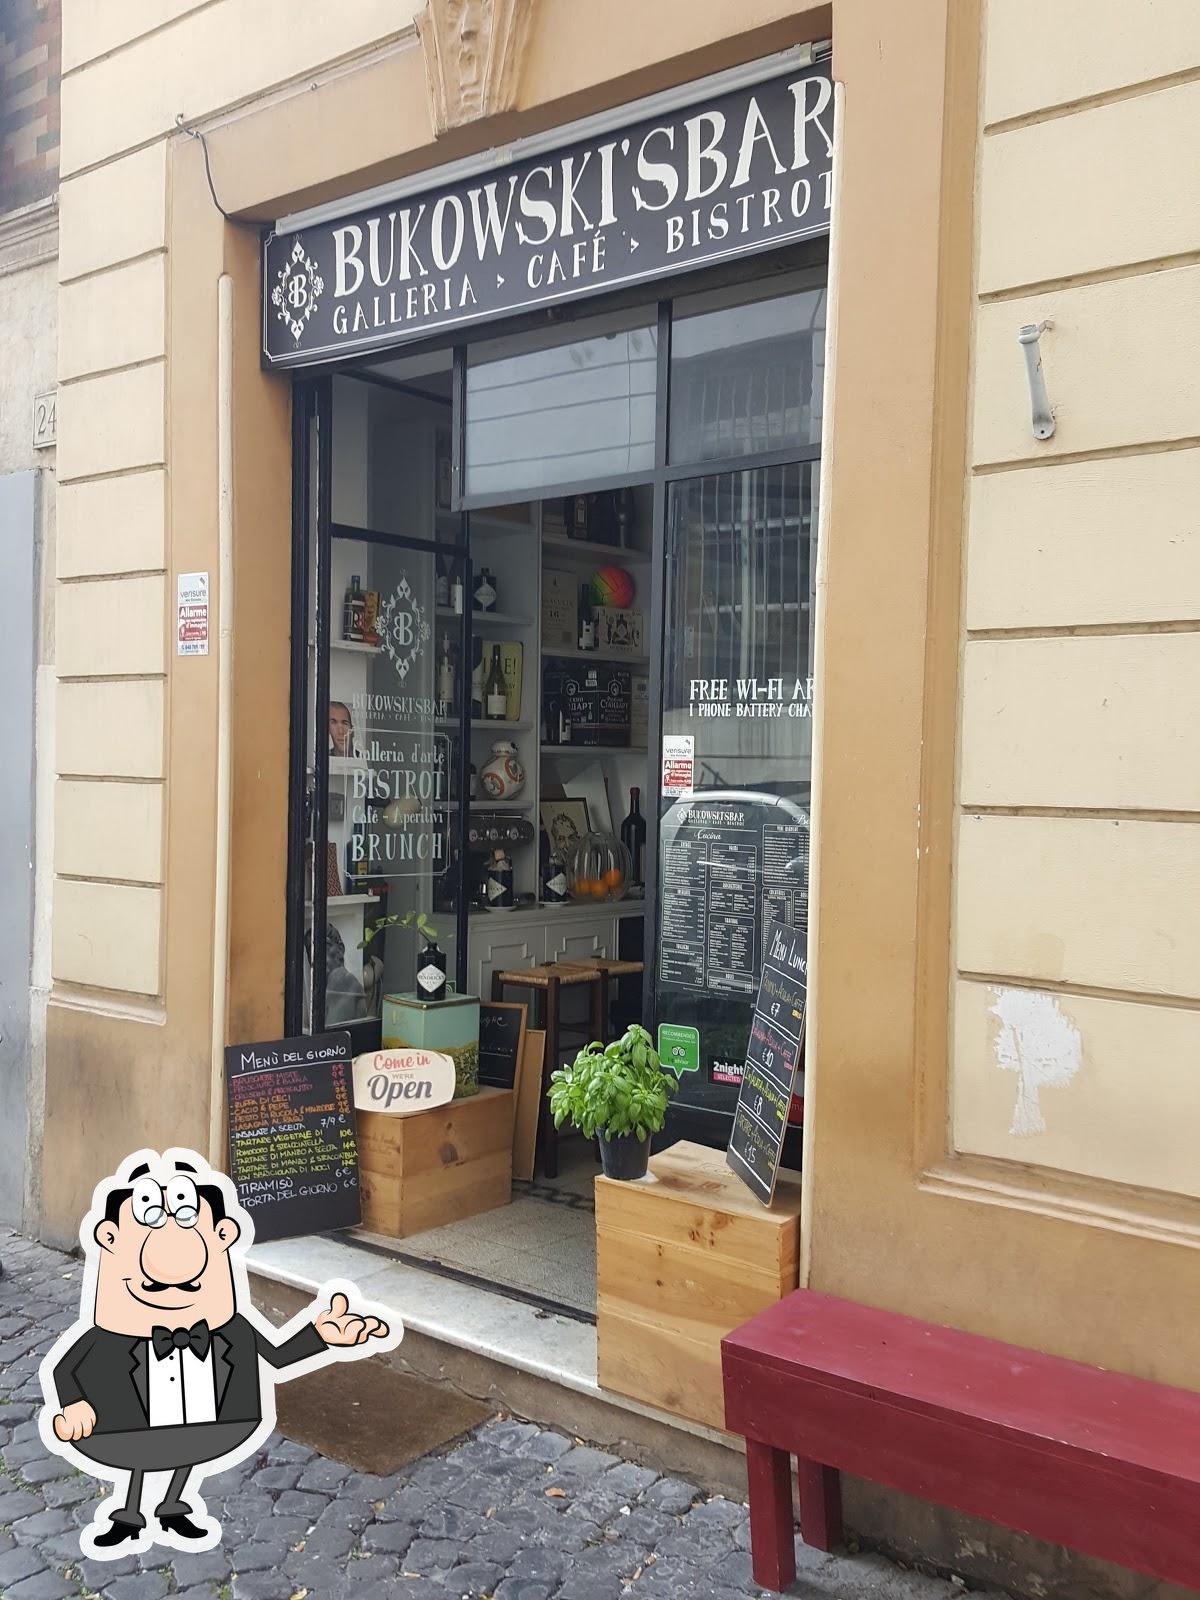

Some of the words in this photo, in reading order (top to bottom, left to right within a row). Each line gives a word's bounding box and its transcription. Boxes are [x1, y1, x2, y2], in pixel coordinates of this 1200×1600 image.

[332, 273, 478, 335] GALLERIA
[527, 230, 606, 289] CAFÉ
[666, 170, 834, 254] BISTROT
[37, 403, 57, 435] 24
[180, 606, 207, 618] Allarme
[690, 679, 728, 700] FREE
[736, 678, 784, 700] WI-FI
[689, 703, 694, 717] I
[698, 703, 731, 717] PHONE
[736, 703, 784, 718] BATTERY
[352, 741, 404, 763] Galleria
[411, 743, 445, 764] d'arte
[352, 768, 445, 800] BISTROT
[352, 805, 379, 824] Café
[392, 806, 444, 831] Aperitivi
[351, 833, 442, 862] BRUNCH
[241, 1051, 279, 1071] MENÙ
[284, 1053, 303, 1063] DEL
[306, 1045, 347, 1060] GIORNO
[373, 1054, 415, 1071] Come
[416, 1052, 431, 1067] in
[713, 1061, 743, 1077] 2night
[717, 1075, 741, 1083] SELECTED
[367, 1074, 433, 1109] Open
[235, 1106, 259, 1117] CACIO
[269, 1101, 290, 1110] PEPE
[235, 1119, 270, 1132] LASAGNA
[270, 1125, 277, 1134] A
[279, 1123, 306, 1132] SCELTA
[236, 1136, 271, 1148] TARTARE
[273, 1130, 313, 1142] VEGETALE
[315, 1128, 323, 1136] DI
[238, 1176, 294, 1196] TIRAMISÙ
[239, 1192, 276, 1209] TORTA
[277, 1189, 298, 1202] DEL
[299, 1182, 338, 1197] GIORNO
